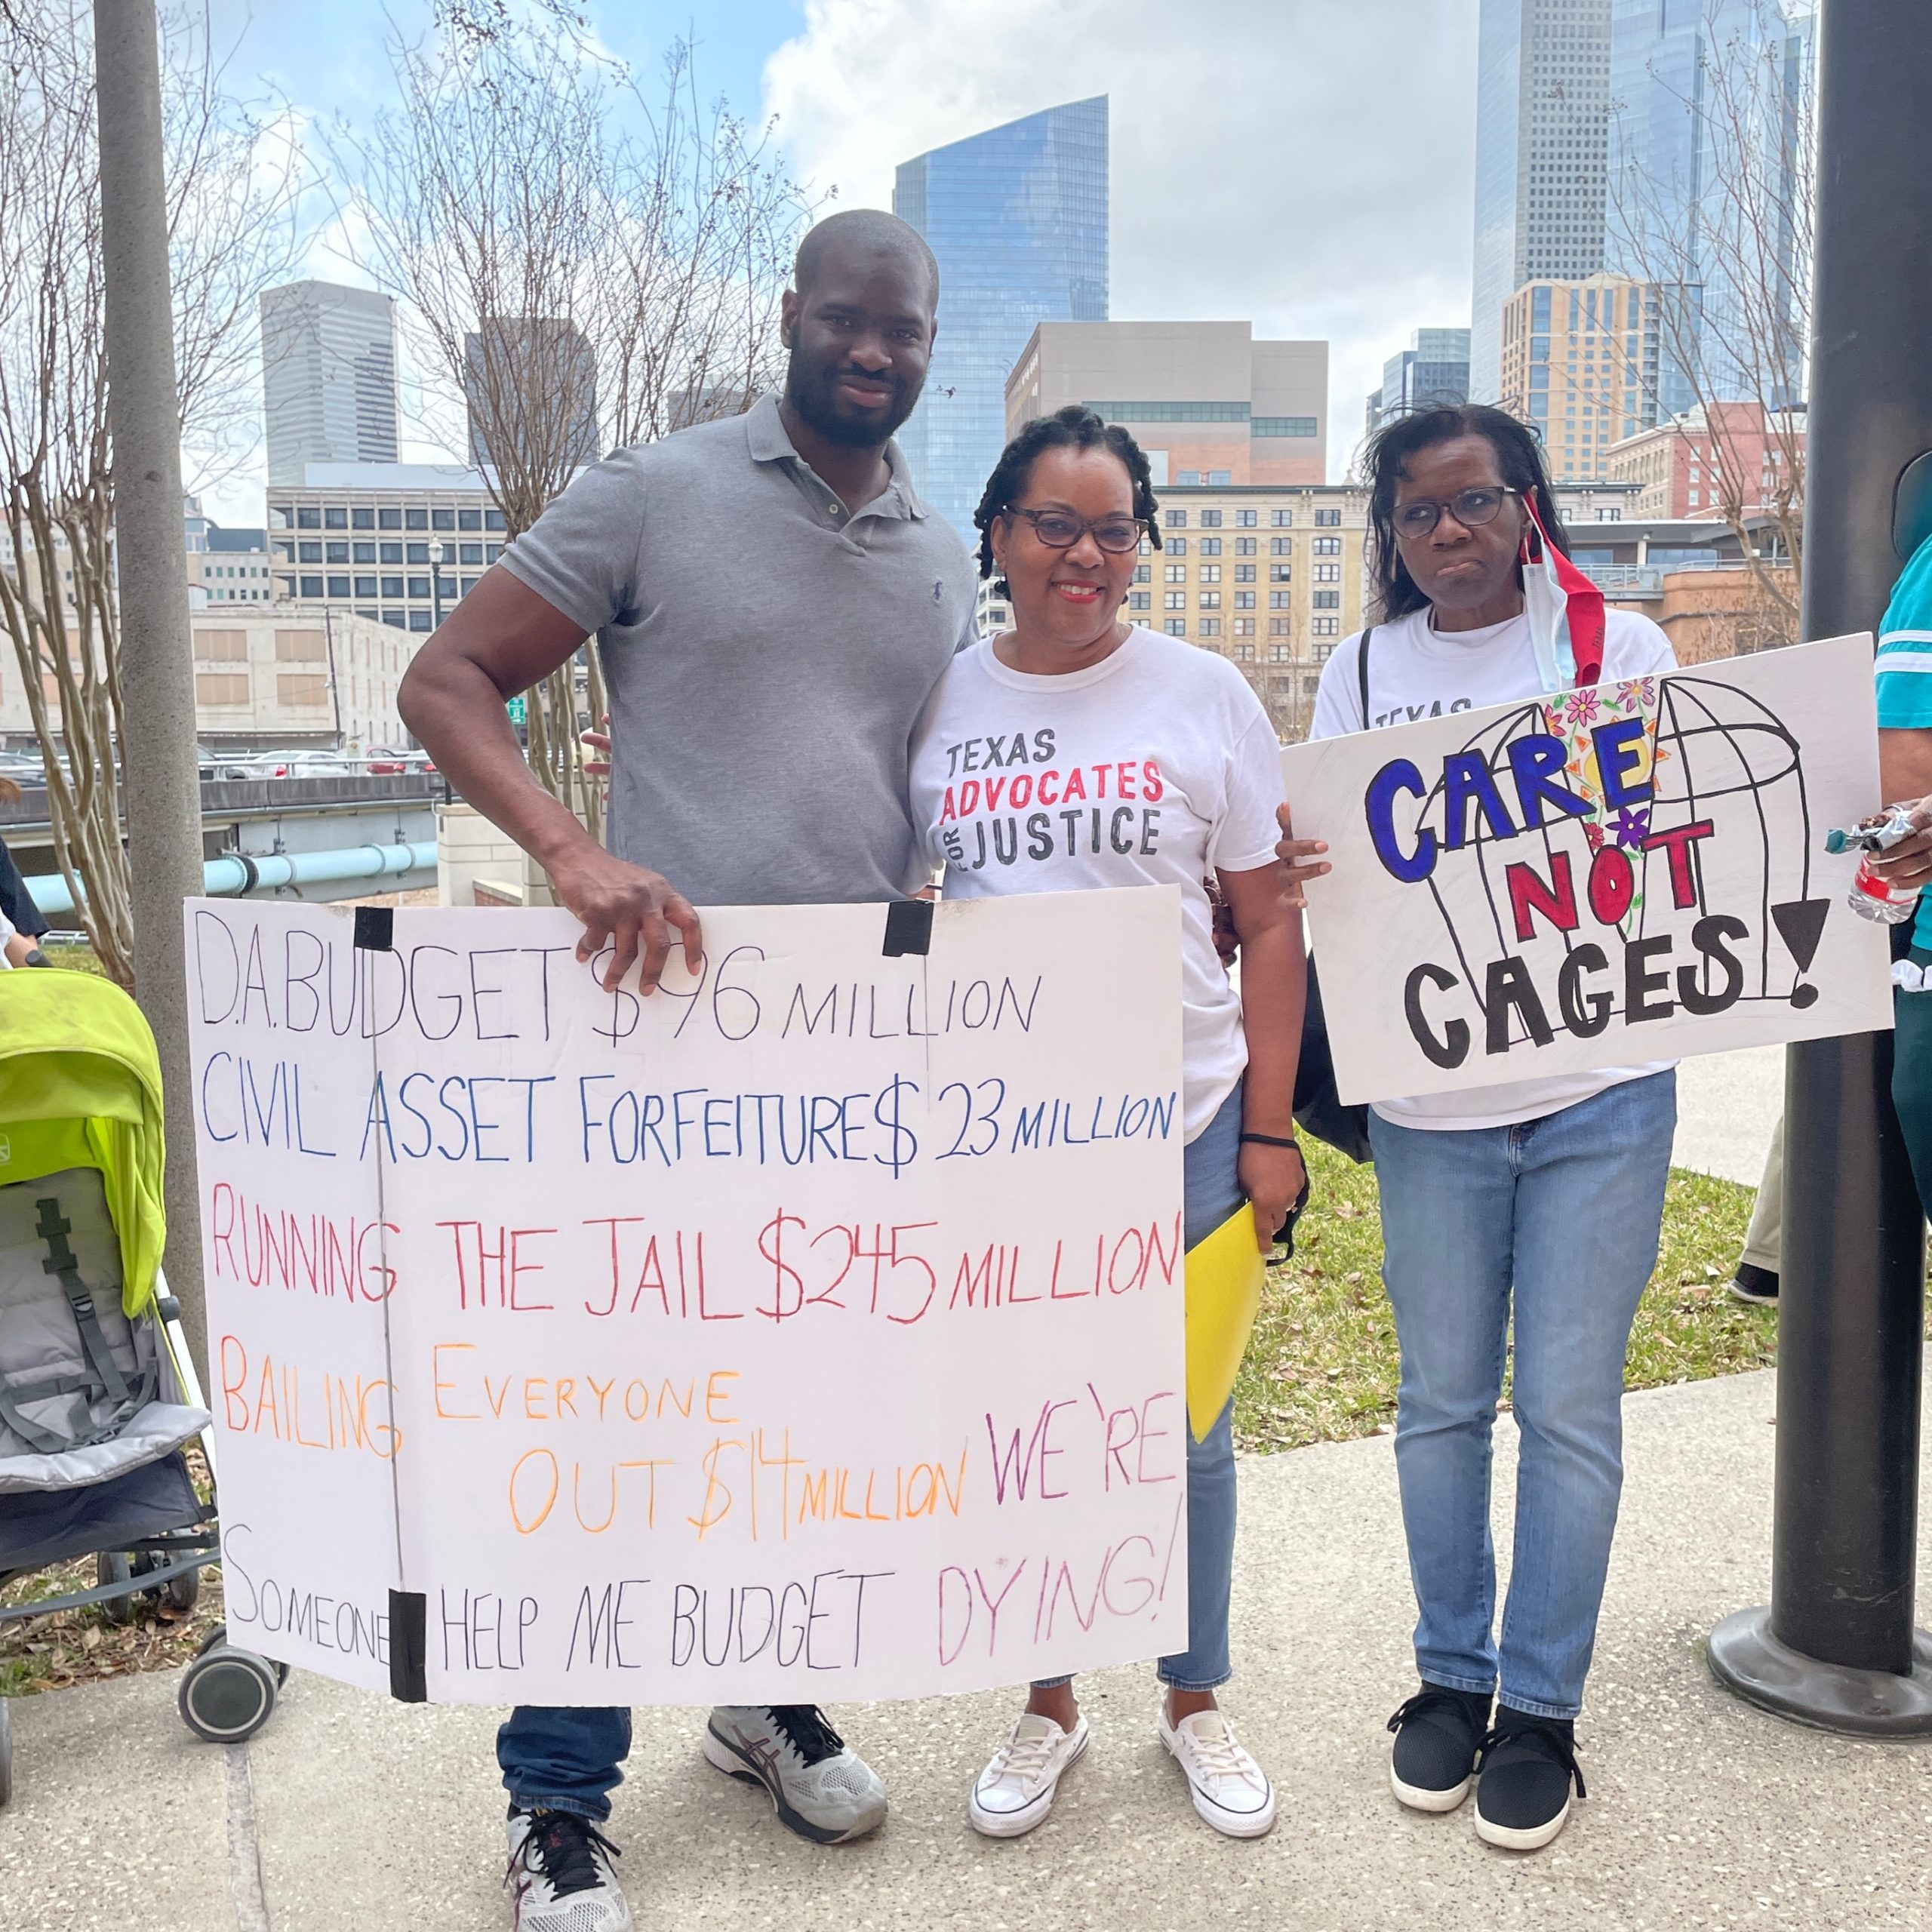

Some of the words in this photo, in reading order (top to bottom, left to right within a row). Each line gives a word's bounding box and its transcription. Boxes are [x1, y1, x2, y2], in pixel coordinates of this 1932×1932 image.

[939, 761, 1164, 826] ADVOCATES
[946, 728, 1057, 778] TEXAS
[1364, 718, 1657, 883] CARE
[943, 826, 969, 872] FOR
[971, 806, 1161, 870] JUSTICE
[1505, 819, 1715, 943] NOT
[782, 975, 1042, 1039] MILLION
[1404, 898, 1832, 1069] CAGES!
[202, 1051, 337, 1157] CIVIL
[360, 1070, 557, 1164] ASSET
[1011, 1091, 1177, 1153] MILLION
[213, 1183, 401, 1303] RUNNING
[435, 1221, 558, 1310] THE
[583, 1217, 744, 1320] JAIL
[755, 1207, 939, 1324] $245
[949, 1210, 1182, 1310] MILLION
[220, 1335, 403, 1458] BAILING
[433, 1343, 741, 1424] EVERYONE
[509, 1448, 676, 1534] OUT
[687, 1426, 809, 1543] $14
[798, 1438, 968, 1524] MILLION
[224, 1523, 390, 1666] SOMEONE
[440, 1583, 539, 1671] HELP
[566, 1579, 652, 1672] ME
[672, 1568, 897, 1669] BUDGET
[938, 1491, 1183, 1667] DYING!
